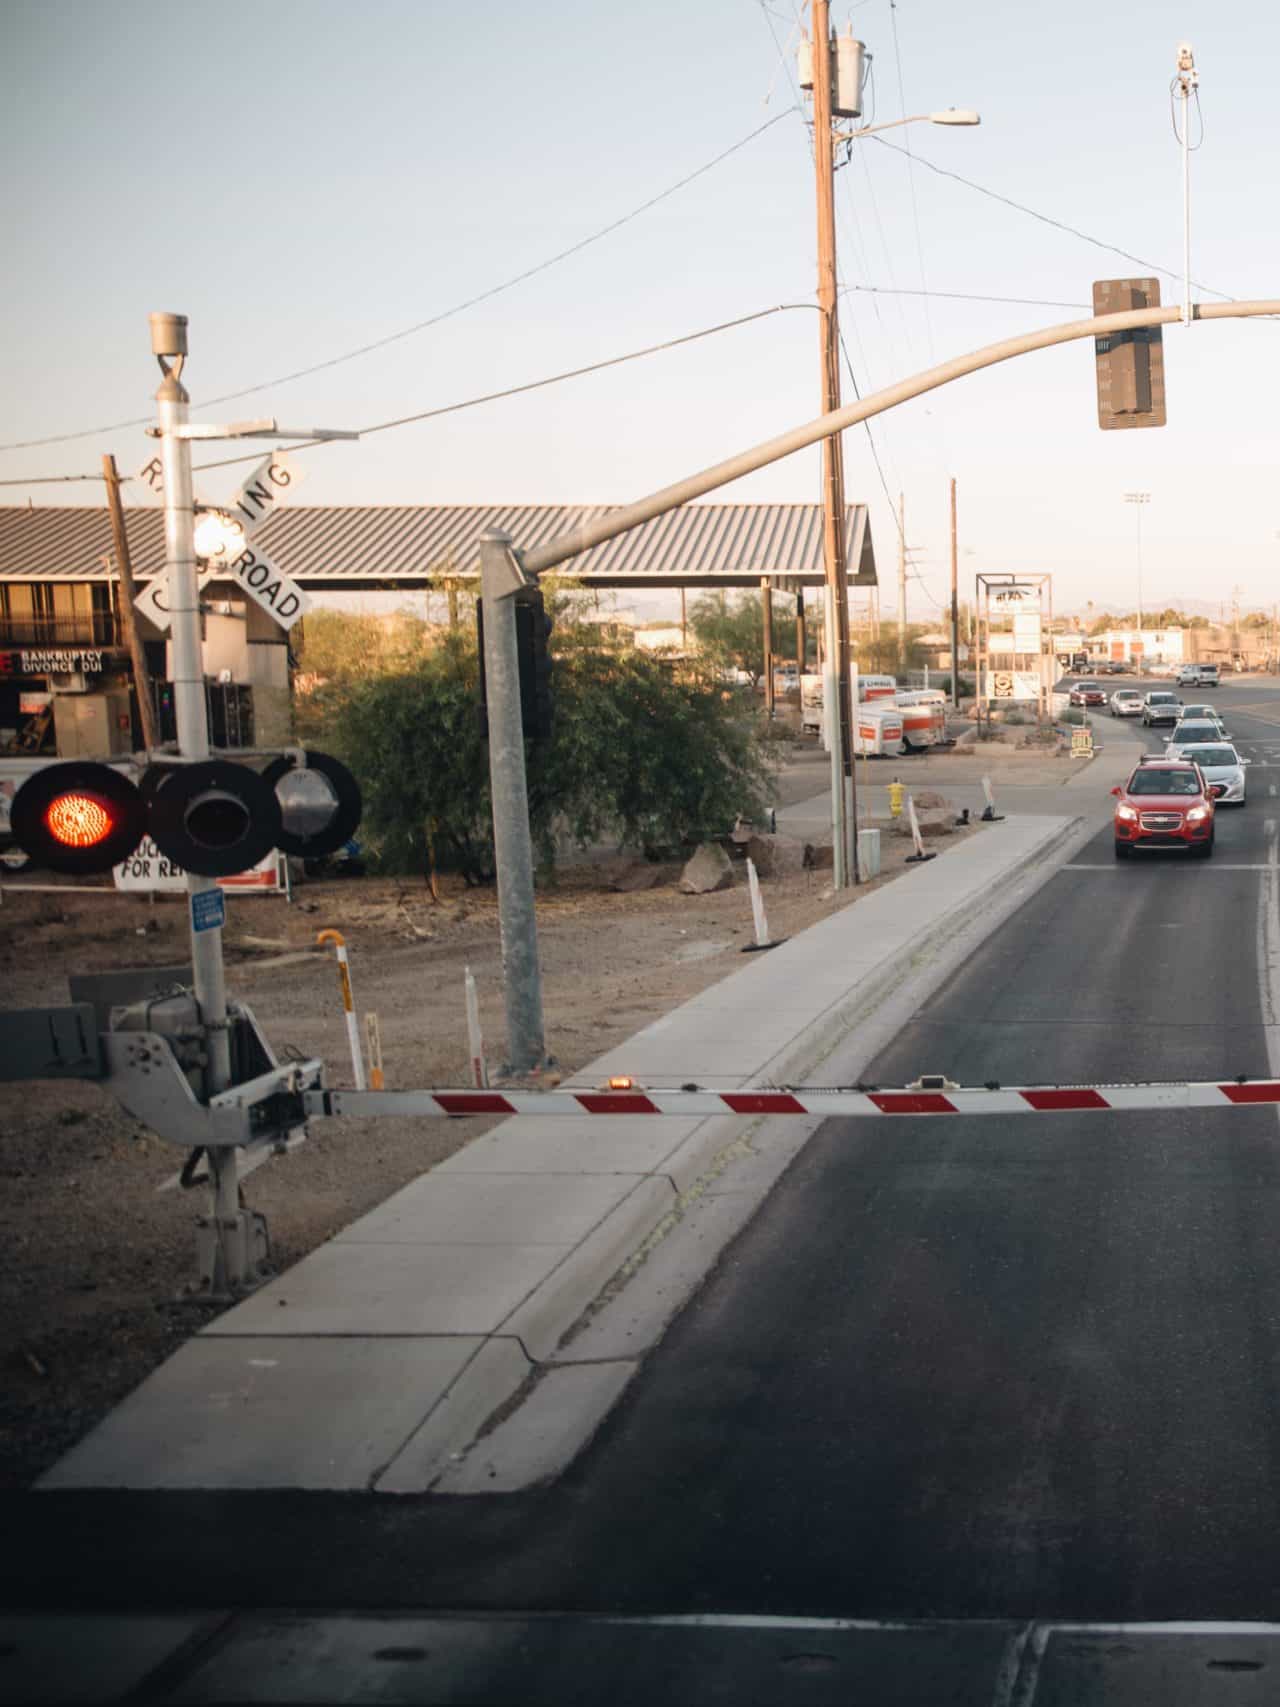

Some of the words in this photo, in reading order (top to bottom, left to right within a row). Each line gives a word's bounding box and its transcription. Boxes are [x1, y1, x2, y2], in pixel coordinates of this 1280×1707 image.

[22, 650, 103, 661] BANKRUPTCY
[22, 662, 73, 672] DIVORCE
[81, 662, 103, 672] DUI
[121, 860, 151, 878] FOR
